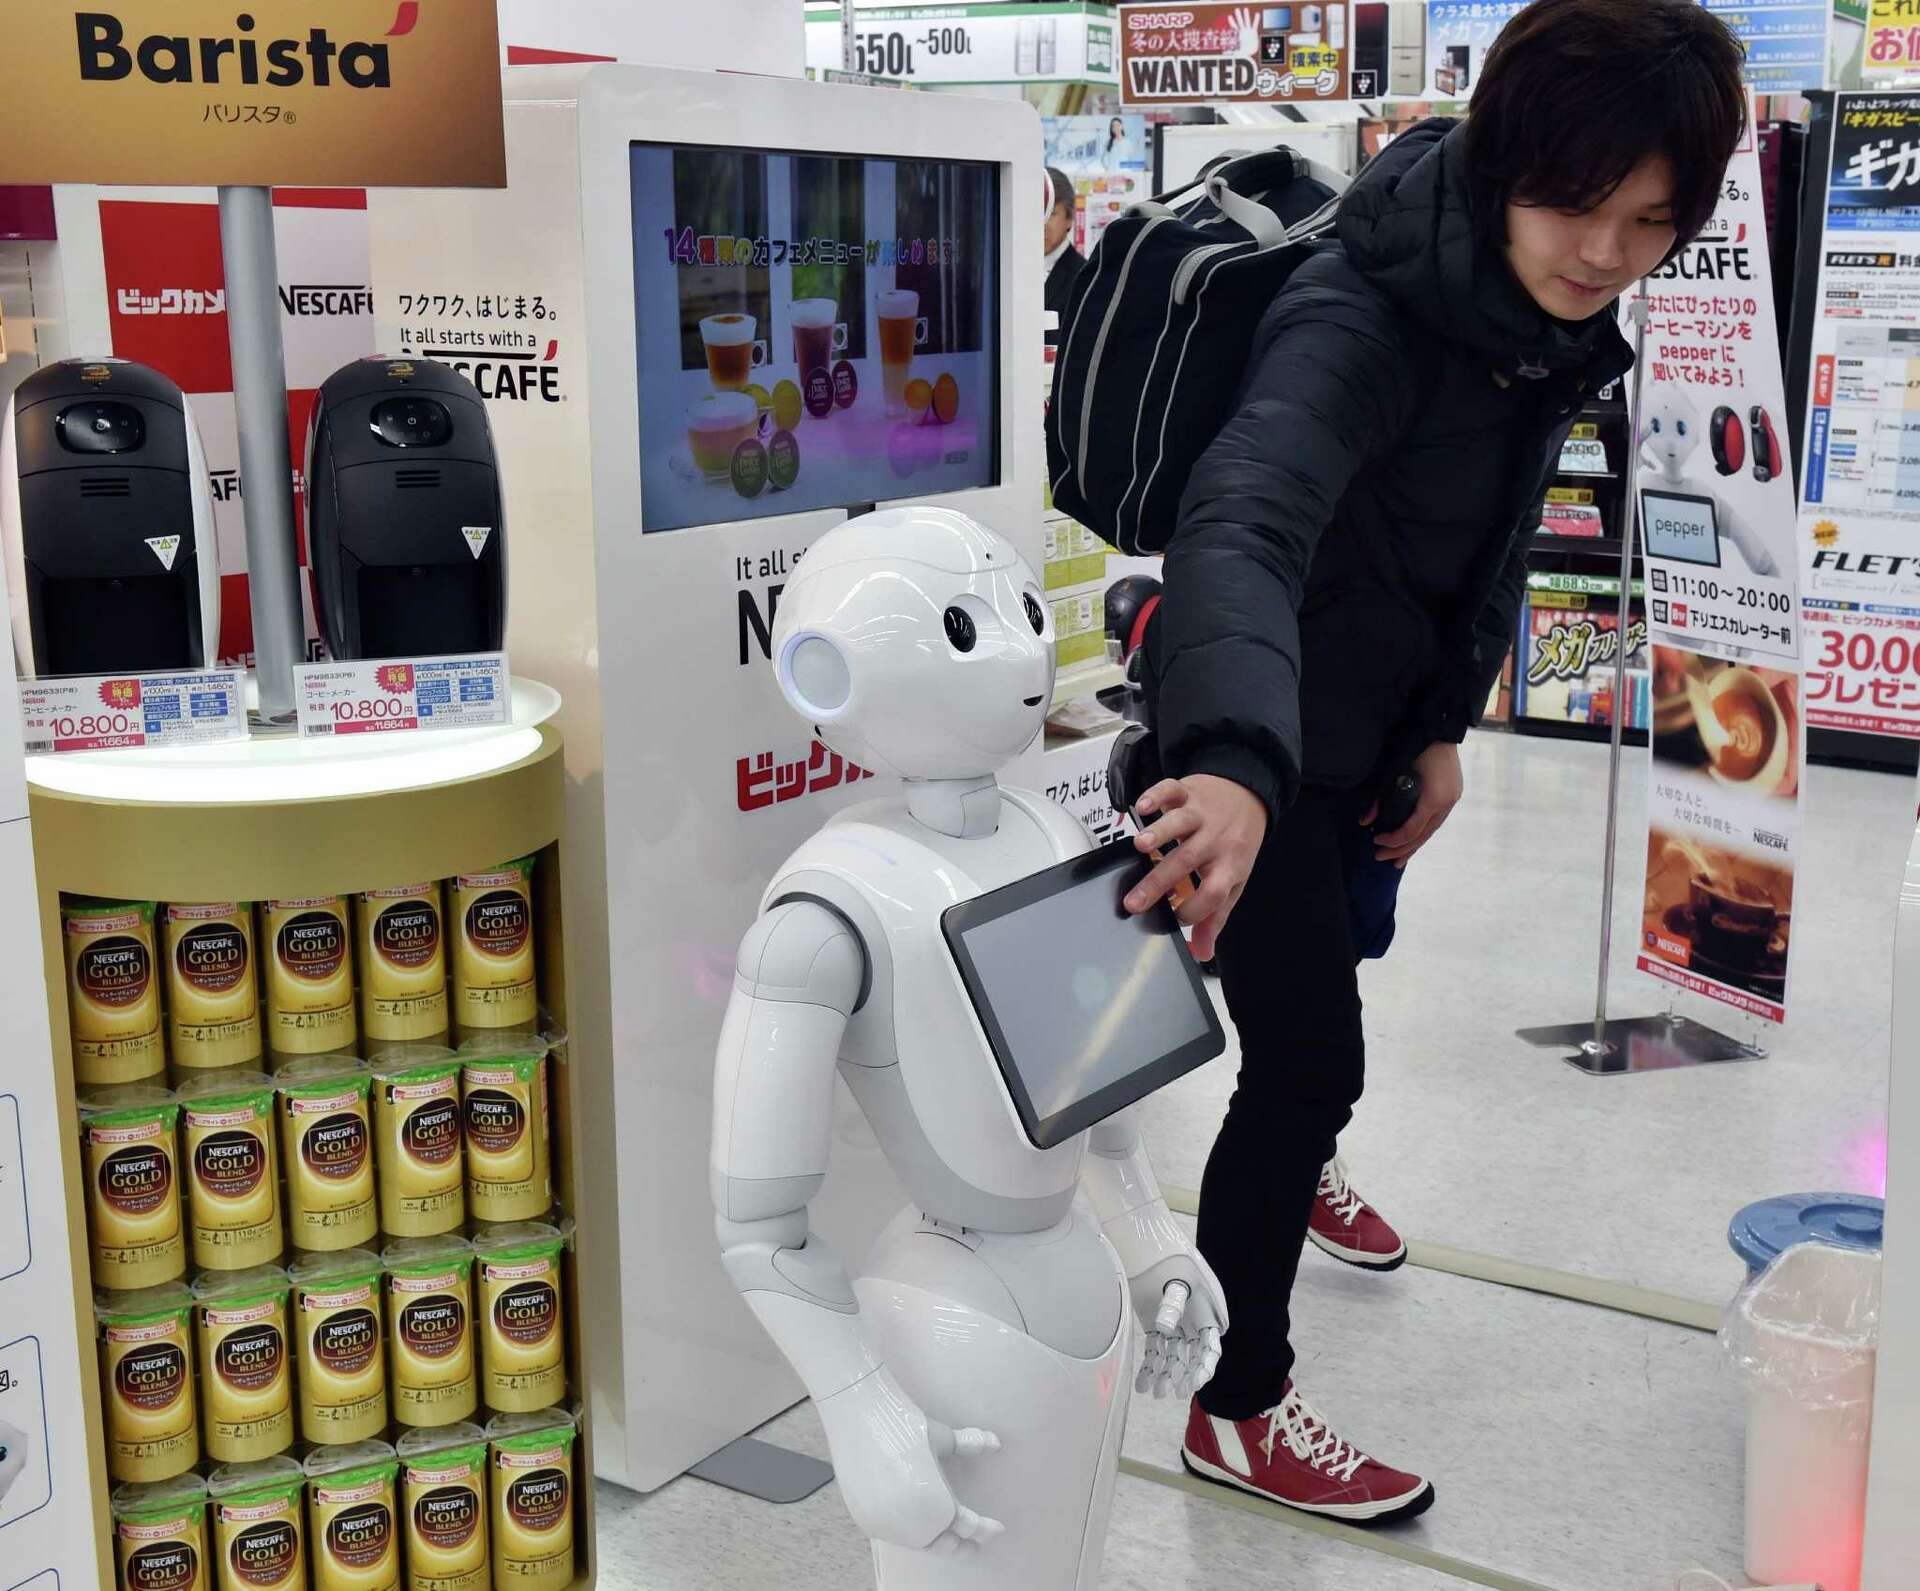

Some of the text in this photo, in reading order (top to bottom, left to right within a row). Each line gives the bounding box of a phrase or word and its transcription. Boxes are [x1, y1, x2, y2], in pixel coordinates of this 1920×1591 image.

[1129, 14, 1192, 28] SHARP
[75, 12, 391, 89] Barista
[1131, 58, 1256, 93] WANTED
[398, 293, 559, 322] ワクワク、はじまる。
[400, 327, 411, 343] It
[415, 328, 435, 344] all
[438, 328, 485, 346] starts
[488, 329, 524, 347] with
[1660, 344, 1717, 362] pepper
[1655, 518, 1705, 541] pepper
[736, 555, 753, 581] It
[759, 552, 787, 576] all
[478, 913, 522, 930] GOLD
[386, 924, 432, 941] GOLD
[289, 936, 337, 953] GOLD
[188, 948, 238, 965] GOLD
[89, 961, 141, 979] GOLD
[470, 1112, 513, 1127] GOLD
[415, 1120, 455, 1140] GOLD
[314, 1135, 360, 1155] GOLD
[205, 1154, 255, 1171] GOLD
[111, 1169, 162, 1187] GOLD
[505, 1303, 550, 1320] GOLD
[410, 1317, 456, 1334] GOLD
[325, 1330, 371, 1350] GOLD
[227, 1347, 276, 1366] GOLD
[127, 1366, 177, 1384] GOLD
[518, 1490, 562, 1507] GOLD
[424, 1507, 470, 1524] GOLD
[337, 1524, 384, 1543] GOLD
[242, 1542, 289, 1562] GOLD
[137, 1563, 188, 1581] GOLD
